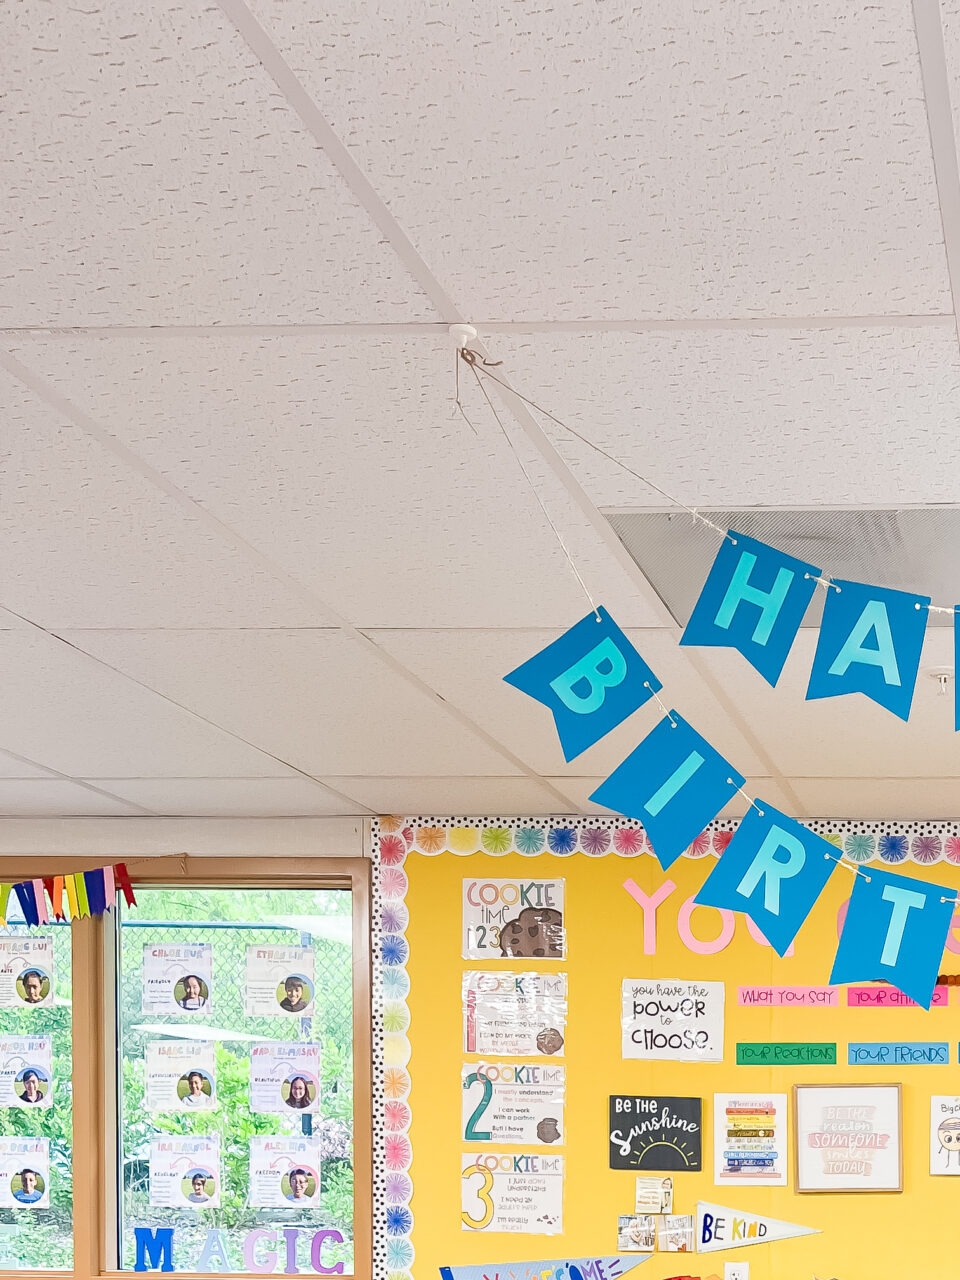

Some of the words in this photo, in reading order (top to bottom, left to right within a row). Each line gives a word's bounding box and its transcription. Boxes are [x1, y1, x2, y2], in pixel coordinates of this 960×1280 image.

[467, 882, 555, 907] COOKIE
[632, 985, 653, 998] you
[656, 984, 685, 997] have
[660, 1013, 673, 1026] to
[477, 1065, 540, 1084] COOKIE
[463, 1072, 493, 1140] 2
[941, 1104, 954, 1114] Big
[610, 1107, 700, 1156] Sunshine
[813, 1133, 883, 1147] SOMEONE
[475, 1154, 539, 1173] COOKIE
[462, 1164, 495, 1229] 3
[701, 1213, 725, 1244] BE
[731, 1215, 768, 1241] KIND
[134, 1227, 345, 1274] MAGIC
